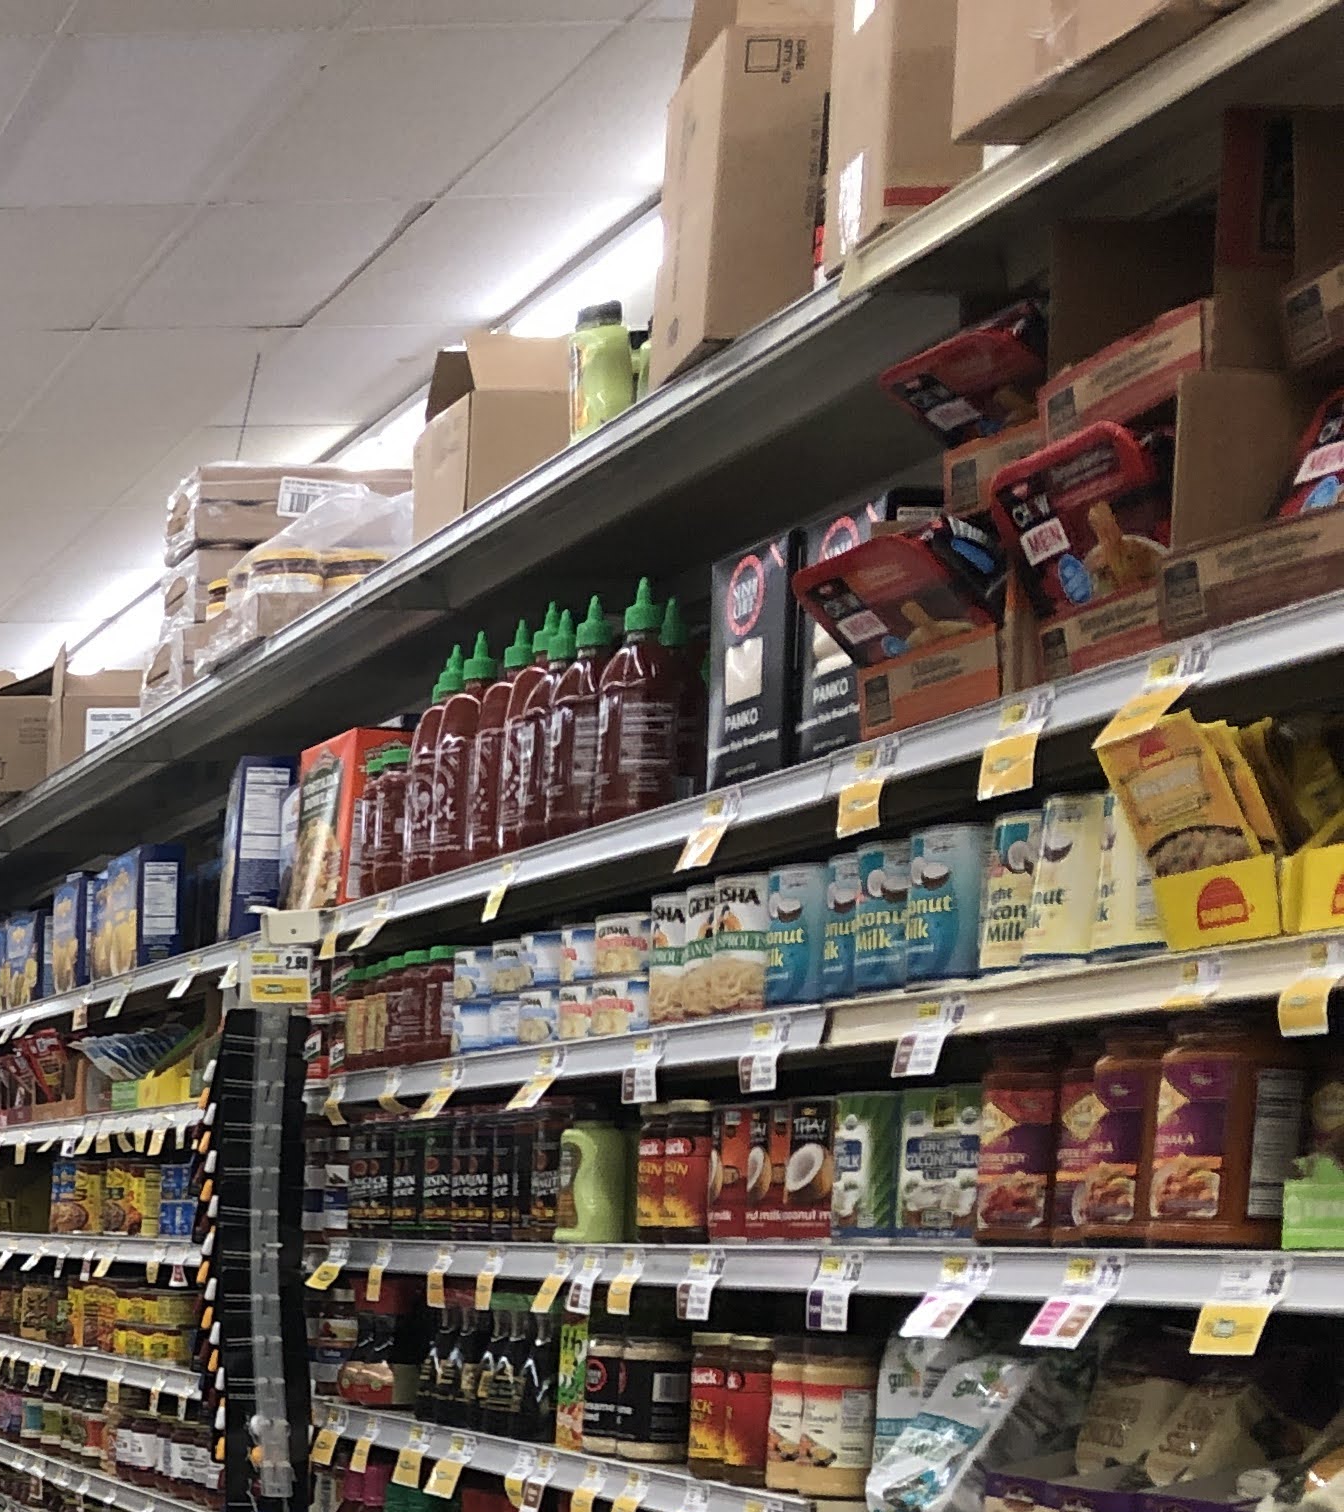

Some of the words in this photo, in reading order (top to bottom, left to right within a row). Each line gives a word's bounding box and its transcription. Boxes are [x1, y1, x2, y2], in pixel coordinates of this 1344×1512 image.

[813, 679, 849, 703] PANKO
[725, 708, 759, 730] PANKO
[719, 887, 759, 906] ISHA
[912, 895, 952, 915] onut
[286, 956, 308, 970] 2.99
